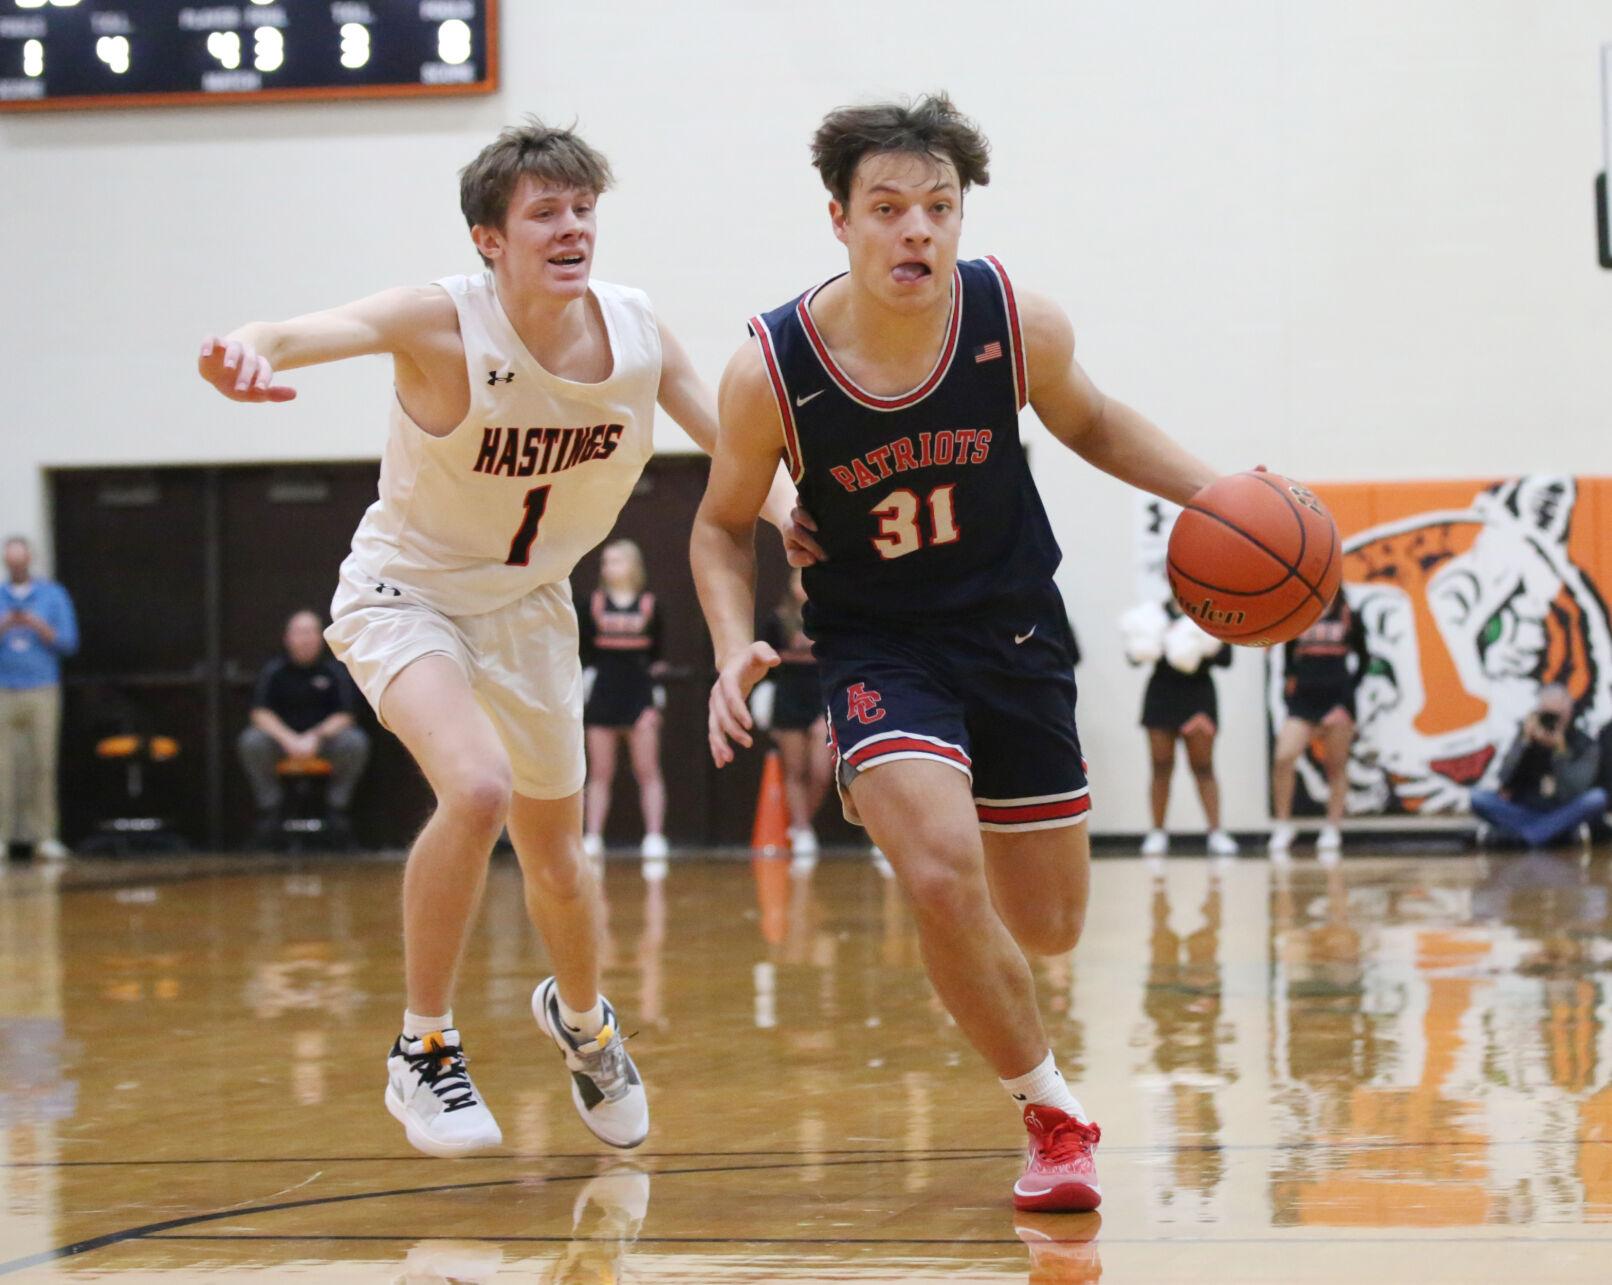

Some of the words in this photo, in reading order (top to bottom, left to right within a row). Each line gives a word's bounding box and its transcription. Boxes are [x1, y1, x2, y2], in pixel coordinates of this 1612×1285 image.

[340, 22, 370, 69] 3
[472, 424, 625, 477] HASTINGS
[830, 429, 992, 492] PATRIOTS
[505, 483, 552, 567] 1
[868, 484, 961, 560] 31
[1178, 597, 1246, 625] den
